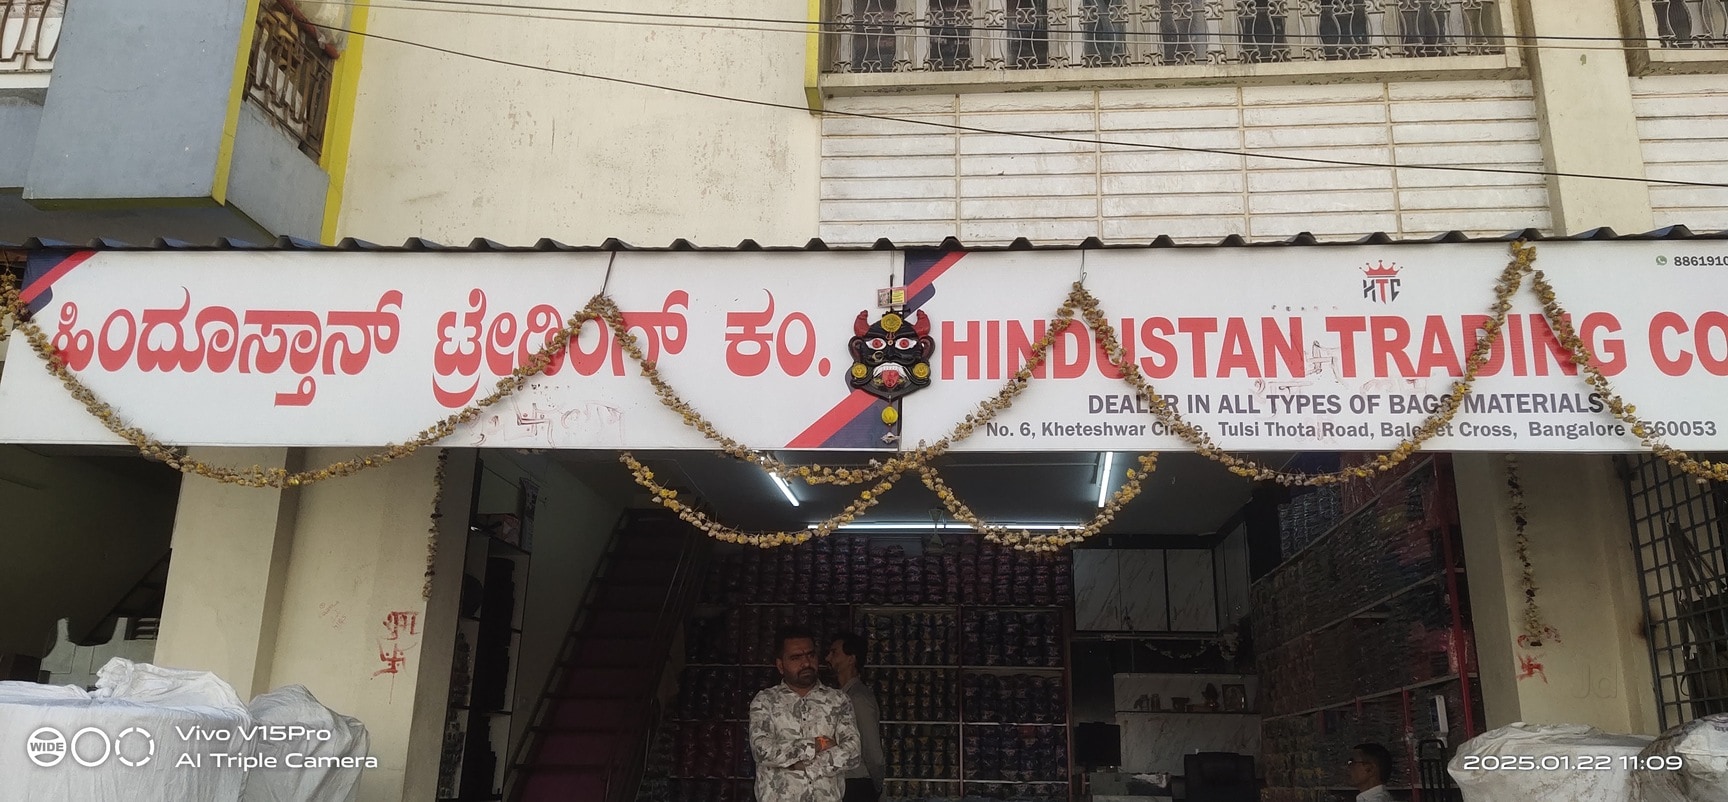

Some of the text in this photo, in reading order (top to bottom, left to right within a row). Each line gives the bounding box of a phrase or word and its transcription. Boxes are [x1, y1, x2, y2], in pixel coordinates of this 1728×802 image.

[1362, 278, 1402, 306] HTC
[49, 285, 831, 408] ಹಿಂದೂಸ್ತಾನ್ ಟ್ರೇಡಿಂಗ್ ಕಂ.
[941, 311, 1728, 381] HINDUSTAN TRADING CO
[1187, 394, 1210, 414] IN
[1218, 394, 1261, 414] ALL
[1266, 394, 1342, 414] TYPES
[1350, 394, 1381, 414] OF
[1464, 393, 1604, 414] MATERIALS
[986, 421, 1014, 437] No.
[1019, 421, 1036, 439] 6,
[1042, 421, 1146, 437] Kheteshwar
[1218, 421, 1259, 437] Tulsi
[1264, 421, 1316, 437] Thota
[1322, 421, 1375, 440] Road,
[1381, 421, 1455, 438] Baleet
[1459, 421, 1518, 439] Cross,
[1528, 420, 1626, 440] Bangalore
